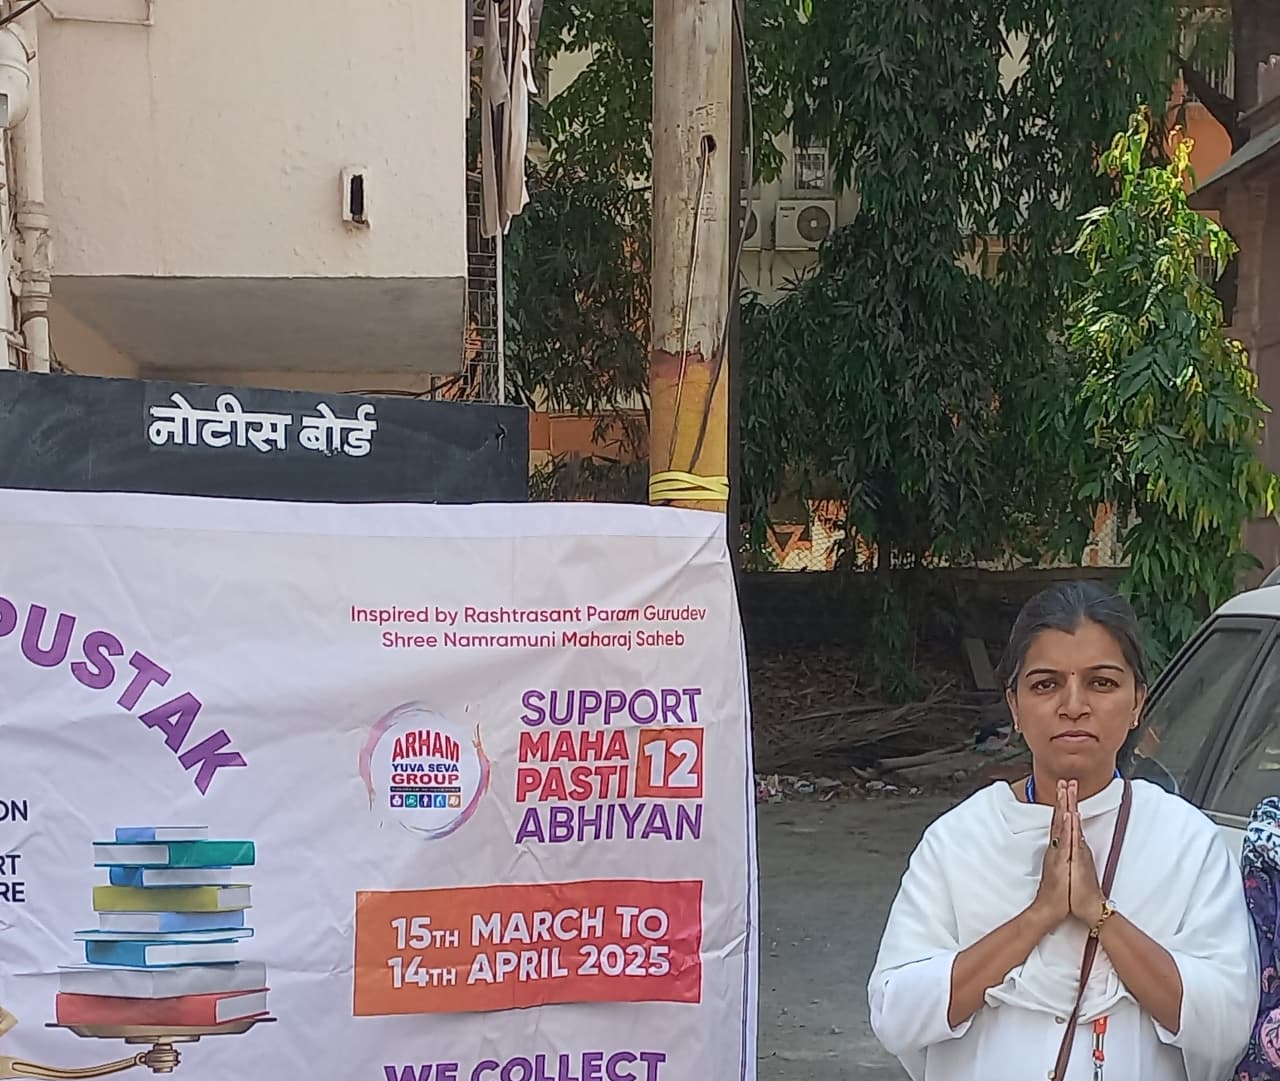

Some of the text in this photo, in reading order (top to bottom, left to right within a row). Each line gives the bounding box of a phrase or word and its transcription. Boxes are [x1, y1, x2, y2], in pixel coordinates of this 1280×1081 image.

[148, 392, 379, 457] नोटीस बोर्ड
[351, 605, 706, 626] Inspired by Rashtrasant Param Gurudev
[382, 630, 685, 651] Shree Namramuni Maharaj Saheb
[519, 688, 702, 728] SUPPORT
[392, 729, 459, 763] ARHAM
[518, 729, 630, 765] MAHA
[642, 739, 700, 788] 12
[391, 773, 459, 785] GROUP
[392, 763, 459, 773] YUVA SEVA
[515, 765, 630, 803] PASTI
[515, 803, 703, 846] ABHIYAN
[390, 906, 668, 951] 15TH MARCH TO
[387, 944, 671, 989] 14TH APRIL 2025
